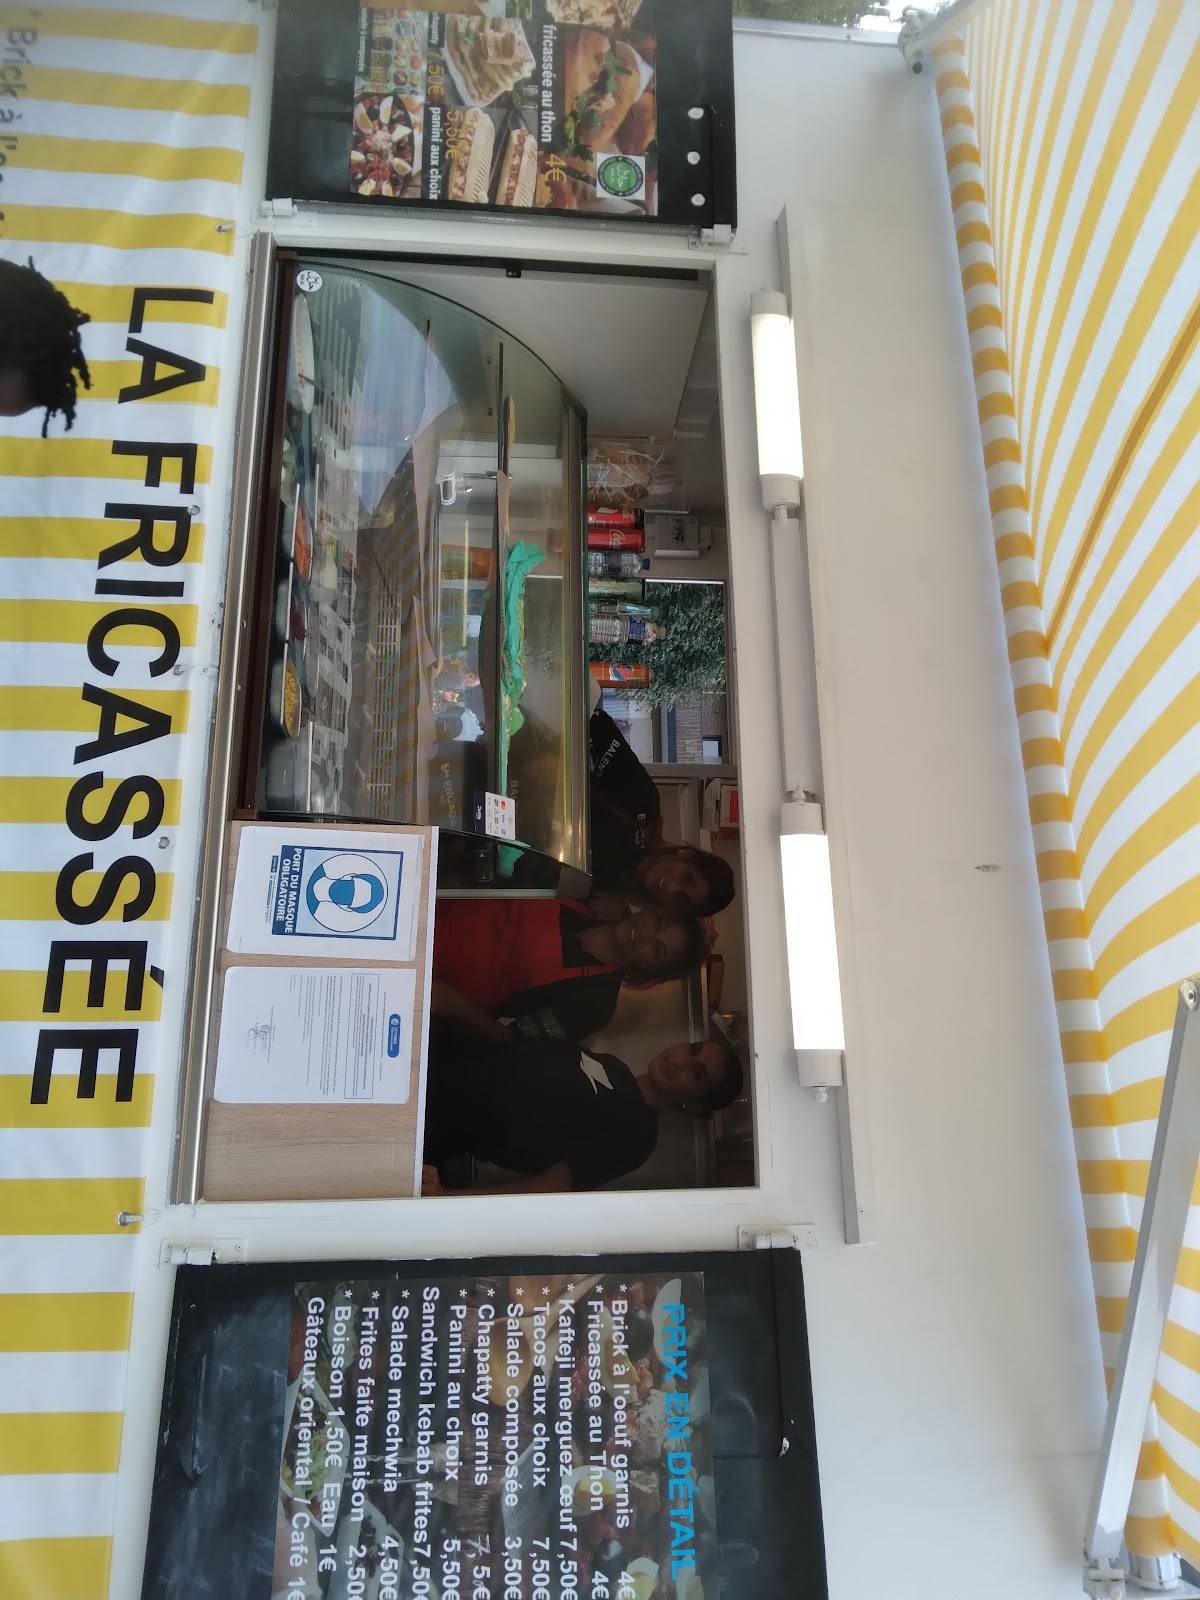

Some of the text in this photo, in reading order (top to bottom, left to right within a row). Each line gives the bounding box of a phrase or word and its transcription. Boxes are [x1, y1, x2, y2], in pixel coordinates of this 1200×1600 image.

[428, 52, 444, 96] 750€
[542, 24, 556, 142] fricassée au thon
[429, 107, 442, 200] panini aux choix
[545, 154, 567, 184] 4€
[30, 286, 214, 1105] LA FRICASSÉE
[276, 858, 290, 922] OBLIGATOIRE
[284, 848, 302, 934] PORT DU MASQUE
[302, 1296, 324, 1390] Gâteaux
[359, 1306, 379, 1370] Frites
[420, 1286, 440, 1396] Sandwich
[472, 1304, 495, 1404] Chapatty
[295, 1397, 316, 1486] oriental
[318, 1306, 352, 1572] Boisson 1,50€ Eau 1€
[356, 1377, 375, 1427] faite
[416, 1404, 435, 1474] kebab
[472, 1412, 492, 1486] garnis
[662, 1304, 698, 1580] PRIX EN DÉTAIL
[350, 1434, 370, 1522] maison
[378, 1306, 409, 1600] Salade mechwia 4,50€
[440, 1304, 466, 1600] Panini au choix 5,50€
[502, 1303, 524, 1600] Salade composée 3,50€
[530, 1302, 550, 1600] Tacos aux choix 7,50€
[554, 1300, 578, 1600] Kafteji merguez œuf 7,50€
[588, 1300, 609, 1600] Fricassée au Thon 4€
[610, 1300, 635, 1600] Brick à l'oeuf garnis 4€
[289, 1512, 310, 1568] Café
[287, 1577, 306, 1600] 1€
